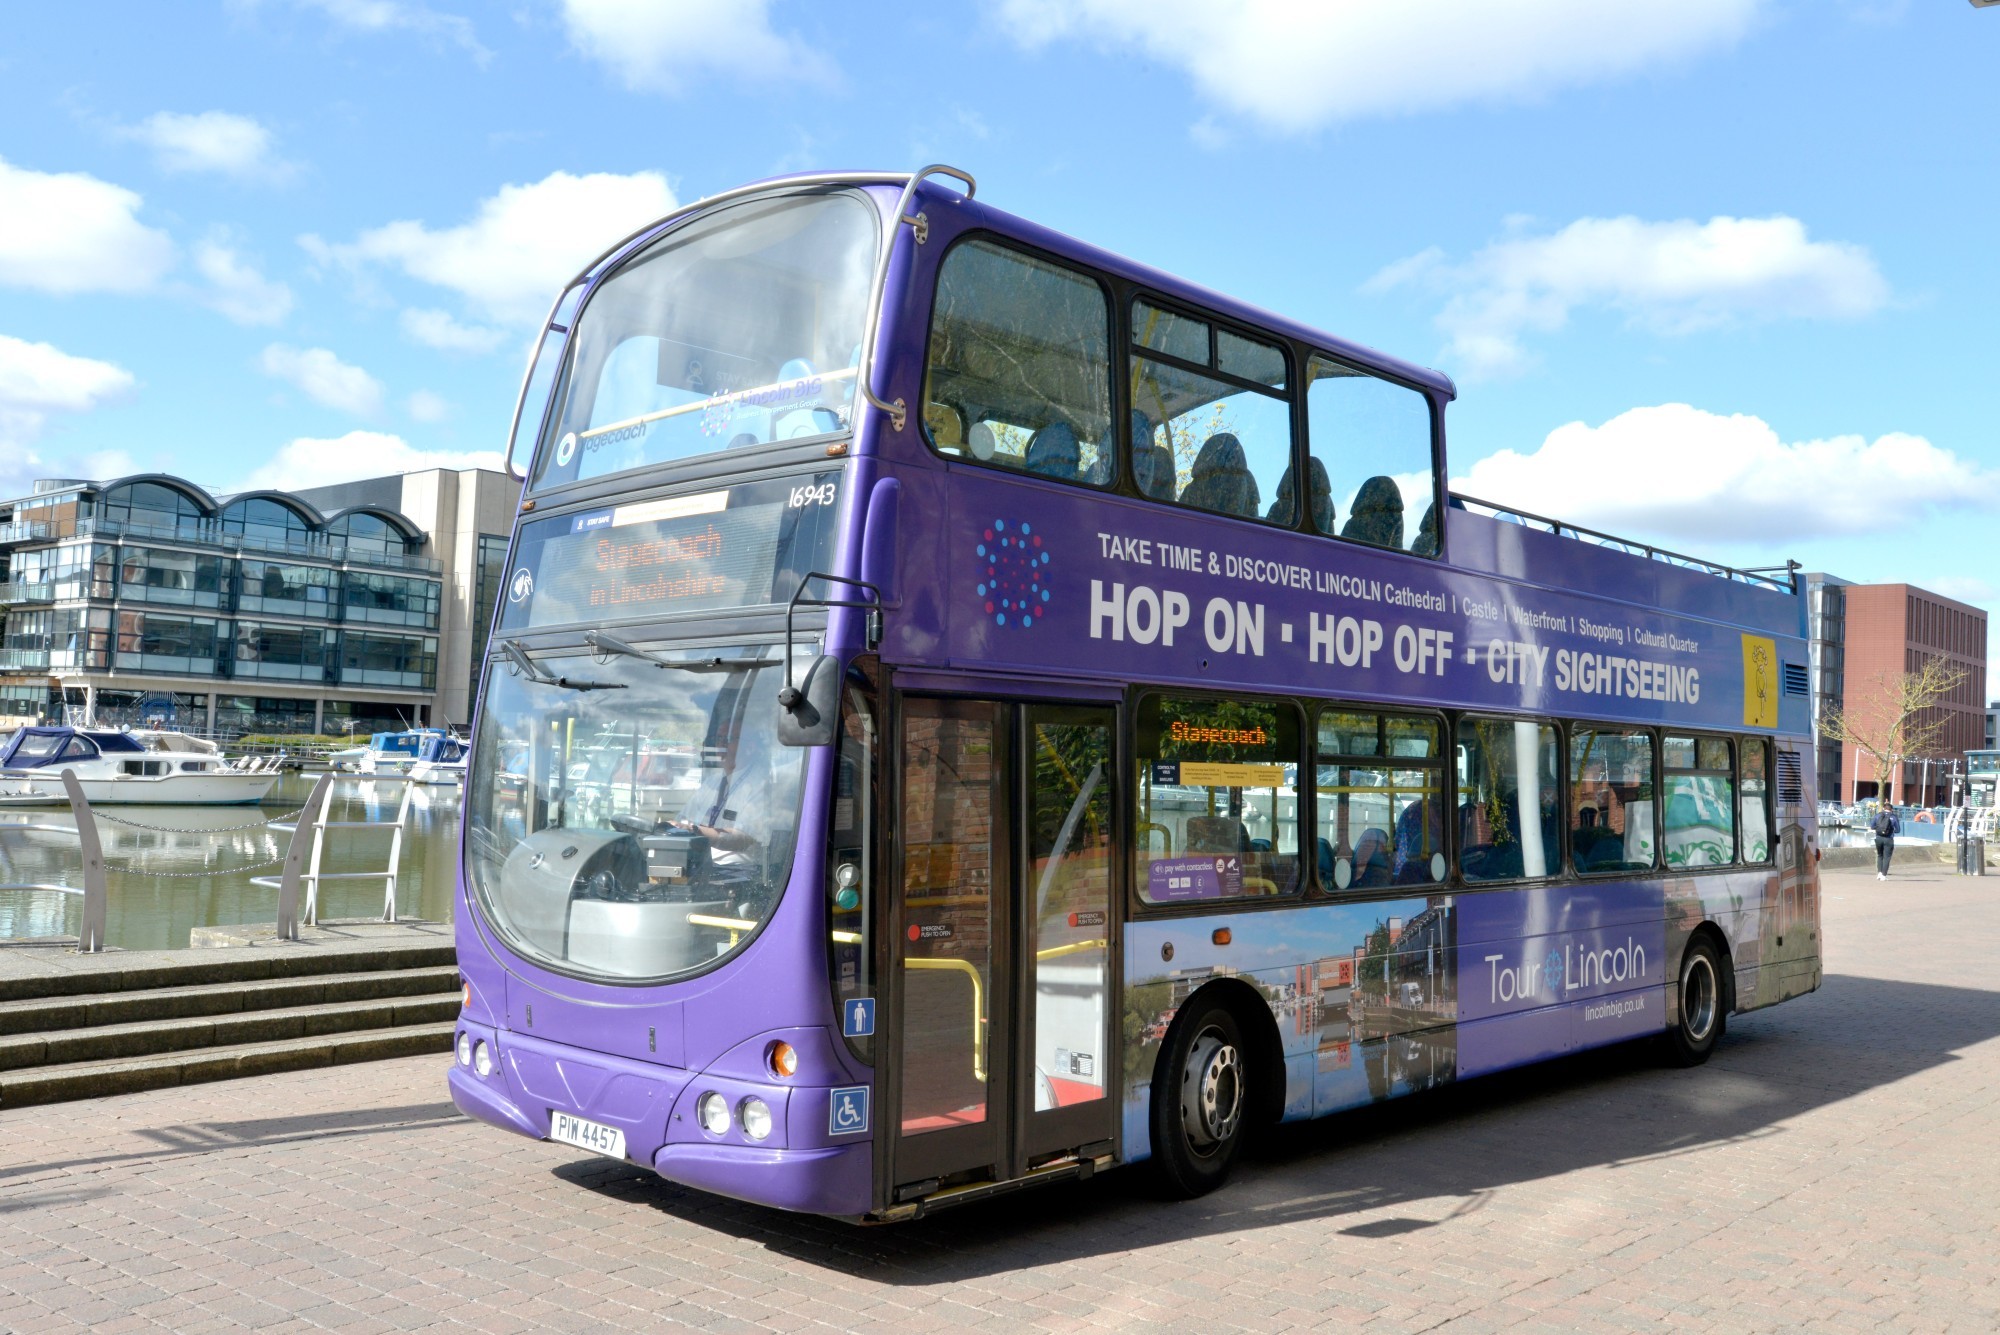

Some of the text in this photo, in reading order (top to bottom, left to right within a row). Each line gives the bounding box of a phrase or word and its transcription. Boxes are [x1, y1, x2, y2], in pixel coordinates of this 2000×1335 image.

[739, 378, 822, 407] Lincoln BIG
[799, 399, 818, 410] Group
[789, 483, 835, 508] 16943
[596, 524, 721, 572] Stagecoach
[590, 570, 726, 607] in Lincolnshire
[1098, 533, 1152, 565] TAKE
[1157, 542, 1203, 573] TIME
[1208, 552, 1221, 575] &
[1226, 555, 1311, 591] DISCOVER
[1316, 570, 1381, 602] LINCOLN
[1385, 583, 1446, 613] Cathedral
[1462, 597, 1498, 621] Castle
[1513, 605, 1566, 633] Waterfront
[1579, 618, 1623, 646] Shopping
[1635, 627, 1667, 649] Cultural
[1669, 633, 1698, 654] Quarter
[1090, 579, 1699, 704] HOP ON HOP OFF CITY SIGHTSEEING
[1171, 721, 1267, 745] Stagecoach
[1164, 861, 1213, 875] pay with contactless
[1485, 936, 1646, 1004] Tour Lincoln
[1585, 996, 1645, 1022] lincolnbig.co.uk
[558, 1115, 618, 1152] PIW 4457
